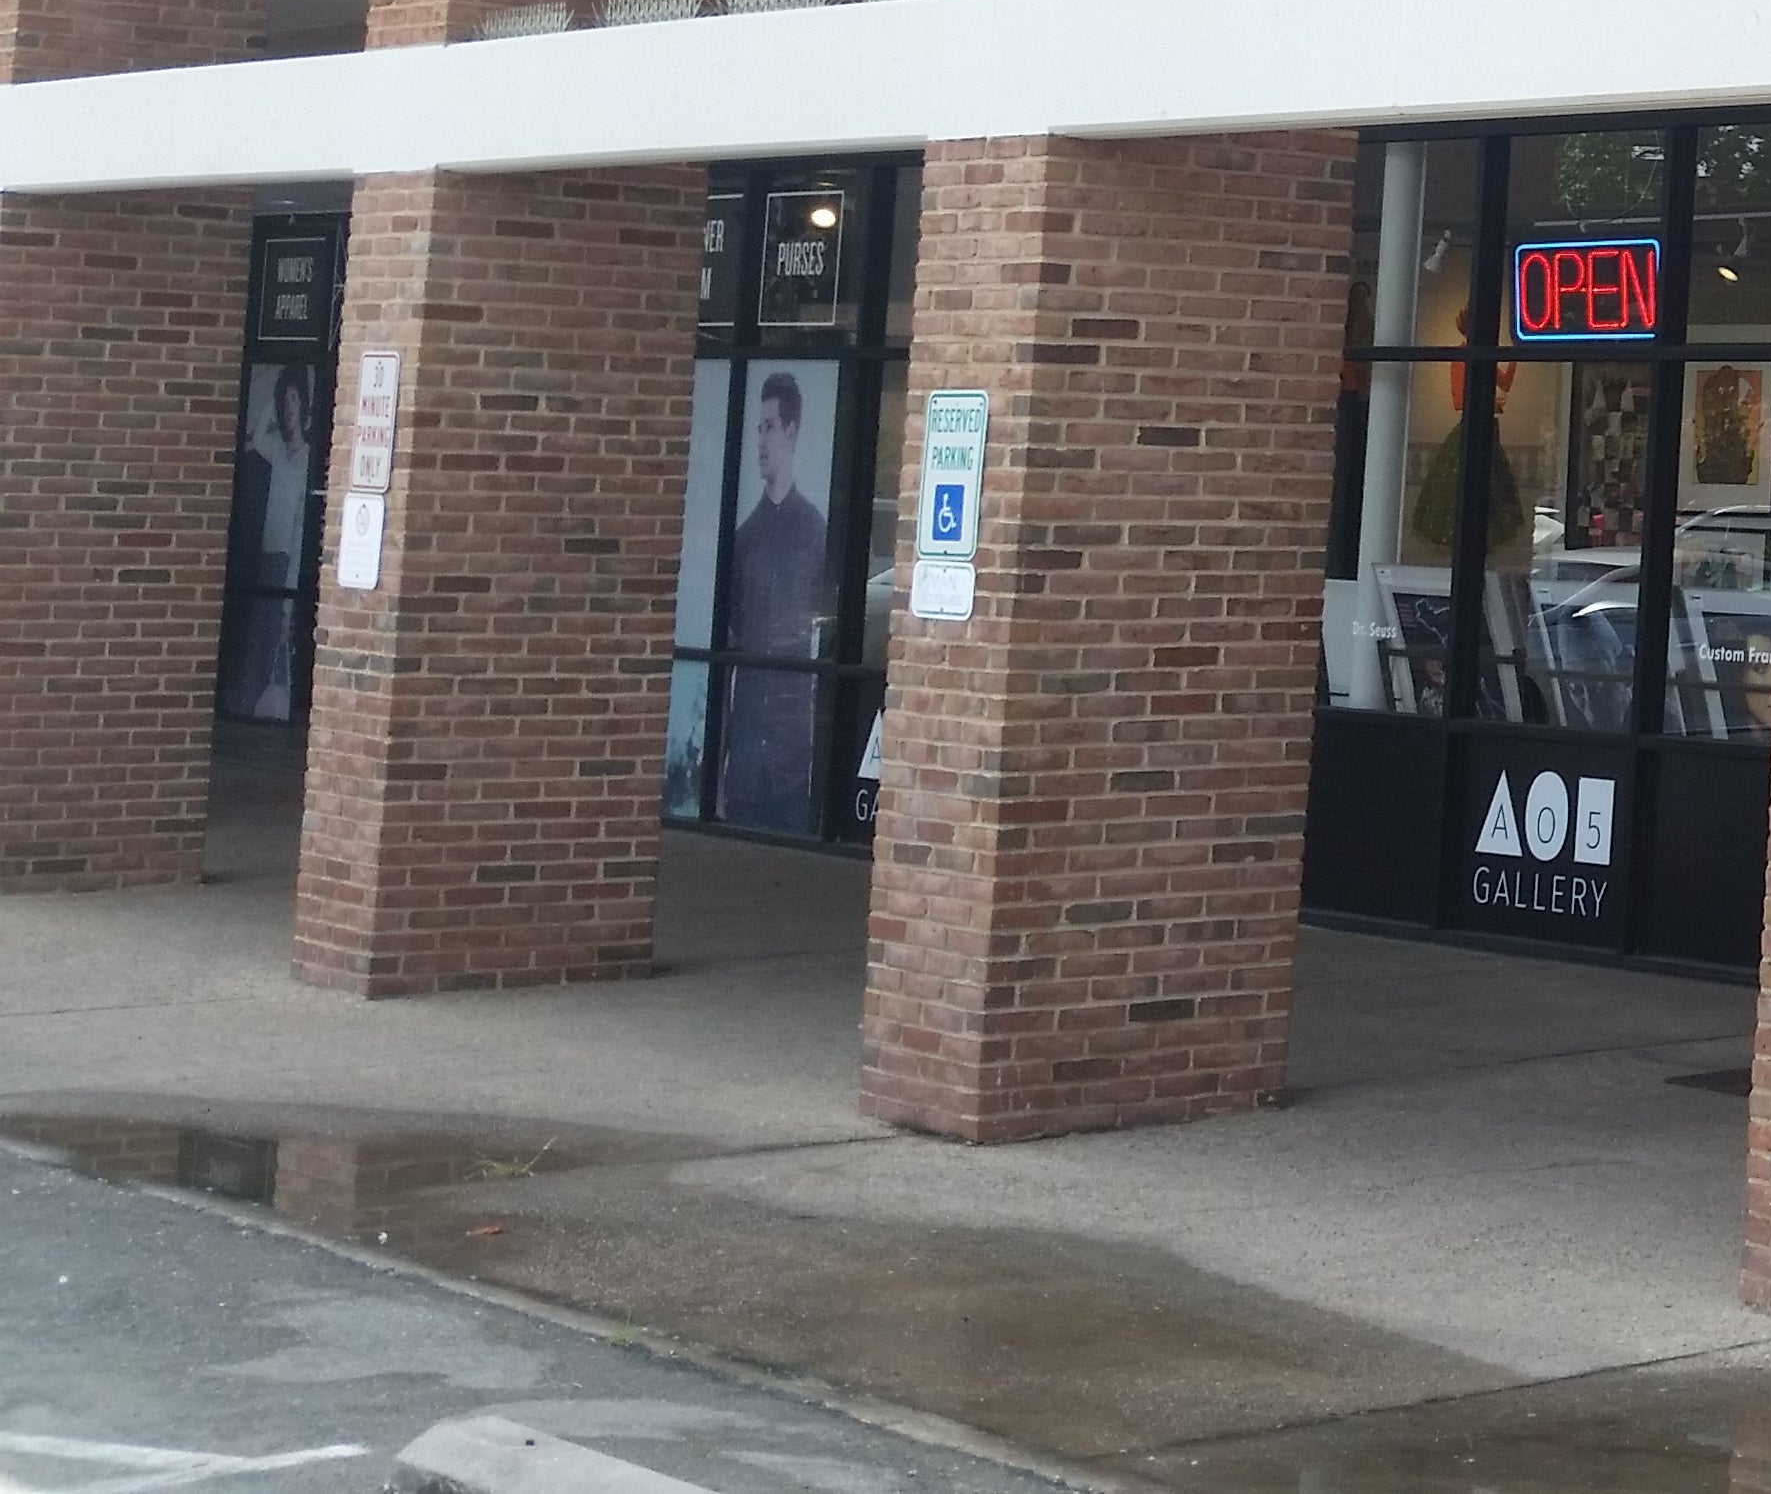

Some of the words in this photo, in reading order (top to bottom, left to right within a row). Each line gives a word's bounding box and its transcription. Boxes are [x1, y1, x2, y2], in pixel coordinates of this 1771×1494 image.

[776, 241, 826, 276] PURSES
[1520, 248, 1656, 330] OPEN
[274, 294, 308, 320] APPAREL
[361, 395, 390, 417] MINUTE
[931, 408, 981, 433] RESERVED
[358, 426, 390, 448] PARKING
[360, 455, 382, 477] ONLY
[932, 445, 974, 471] PARKING
[1369, 622, 1397, 639] Seuss
[1699, 644, 1745, 663] Custom
[1473, 866, 1608, 918] GALLERY
